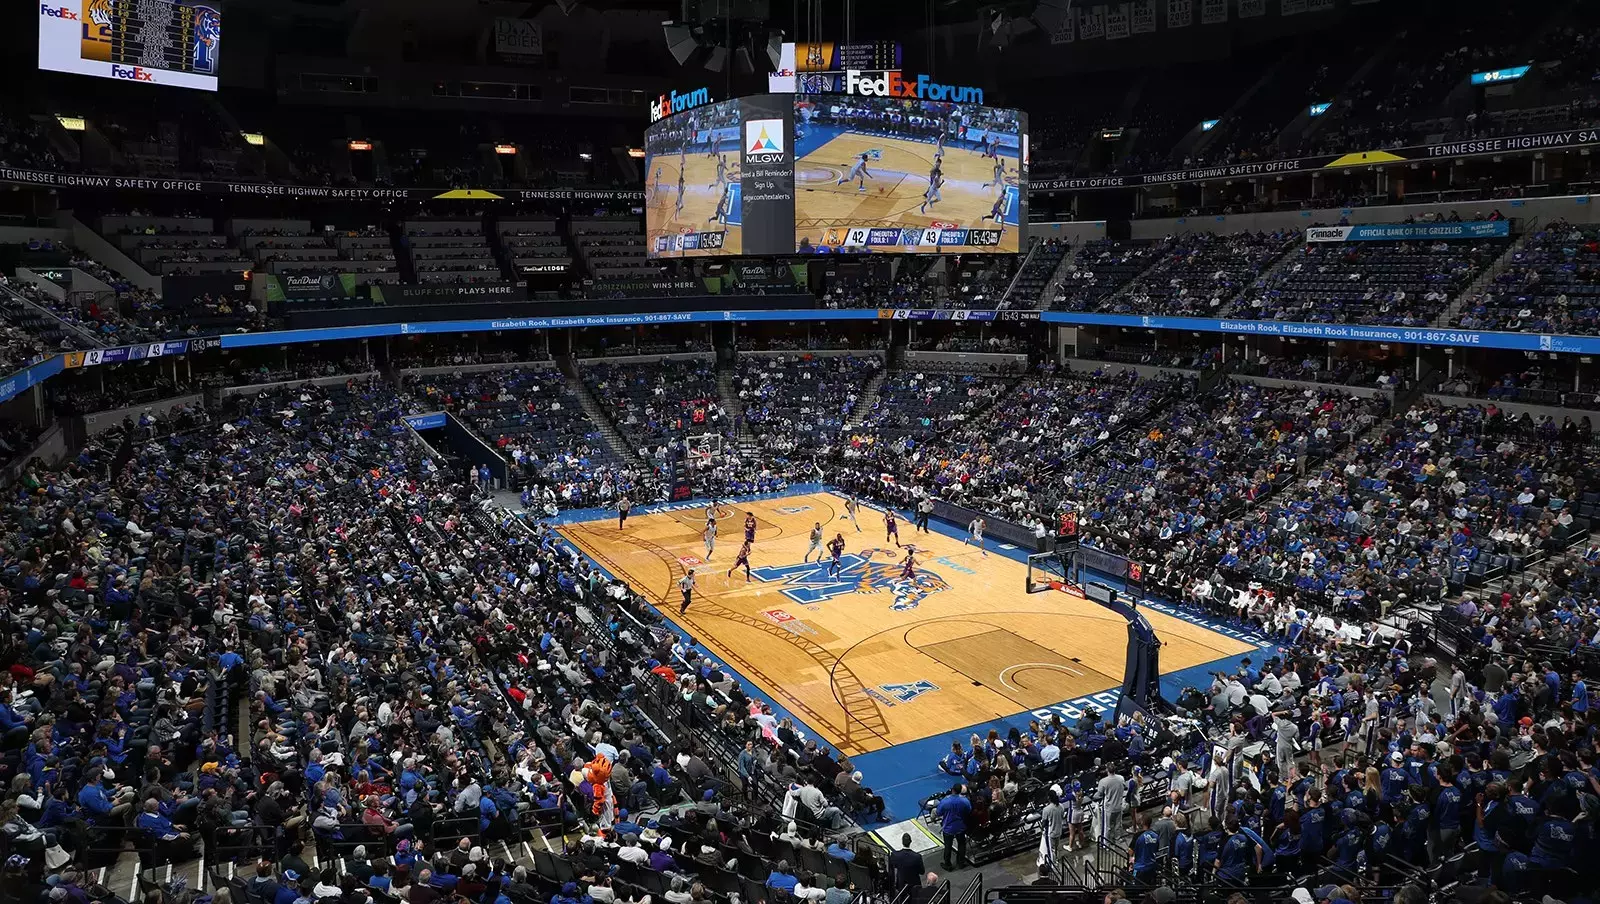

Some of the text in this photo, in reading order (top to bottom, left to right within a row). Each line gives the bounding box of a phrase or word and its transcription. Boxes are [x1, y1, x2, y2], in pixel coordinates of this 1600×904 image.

[41, 4, 77, 21] FedEx
[112, 65, 152, 81] FedEx
[847, 69, 984, 104] FedExForum
[1428, 140, 1501, 156] TENNESSEE
[1507, 133, 1573, 149] HIGHWAY
[746, 154, 784, 163] MLGW
[765, 169, 792, 177] Reminder?
[1143, 160, 1300, 184] TENNESSEE HIGHWAY SAFETY OFFICE
[1, 168, 202, 192] TENNESSEE HIGHWAY SAFETY OFFICE
[754, 181, 765, 190] Sign
[1053, 179, 1087, 189] SAFETY
[1089, 177, 1124, 188] OFFICE
[228, 184, 409, 198] TENNESSEE HIGHWAY SAFETY OFFICE
[520, 191, 571, 199] TENNESSEE
[574, 191, 614, 199] HIGHWAY
[852, 231, 864, 244] 42
[925, 231, 936, 244] 43
[970, 231, 990, 245] 15:43
[1310, 228, 1343, 239] Pinnacle
[1359, 226, 1462, 238] OFFICIAL BANK OF THE GRIZZLIES
[287, 275, 321, 285] FanDuel
[403, 286, 514, 296] BLUFF CITY PLAYS HERE.
[492, 313, 691, 328] Elizabeth Rook, Elizabeth Rook Insurance, 901-867-SAVE
[956, 311, 965, 319] 43
[1002, 311, 1019, 321] 15:43
[1220, 321, 1480, 344] Elizabeth Rook, Elizabeth Rook Insurance, 901-867-SAVE
[152, 345, 160, 356] 43
[191, 340, 206, 352] 15:43
[89, 352, 99, 365] 42
